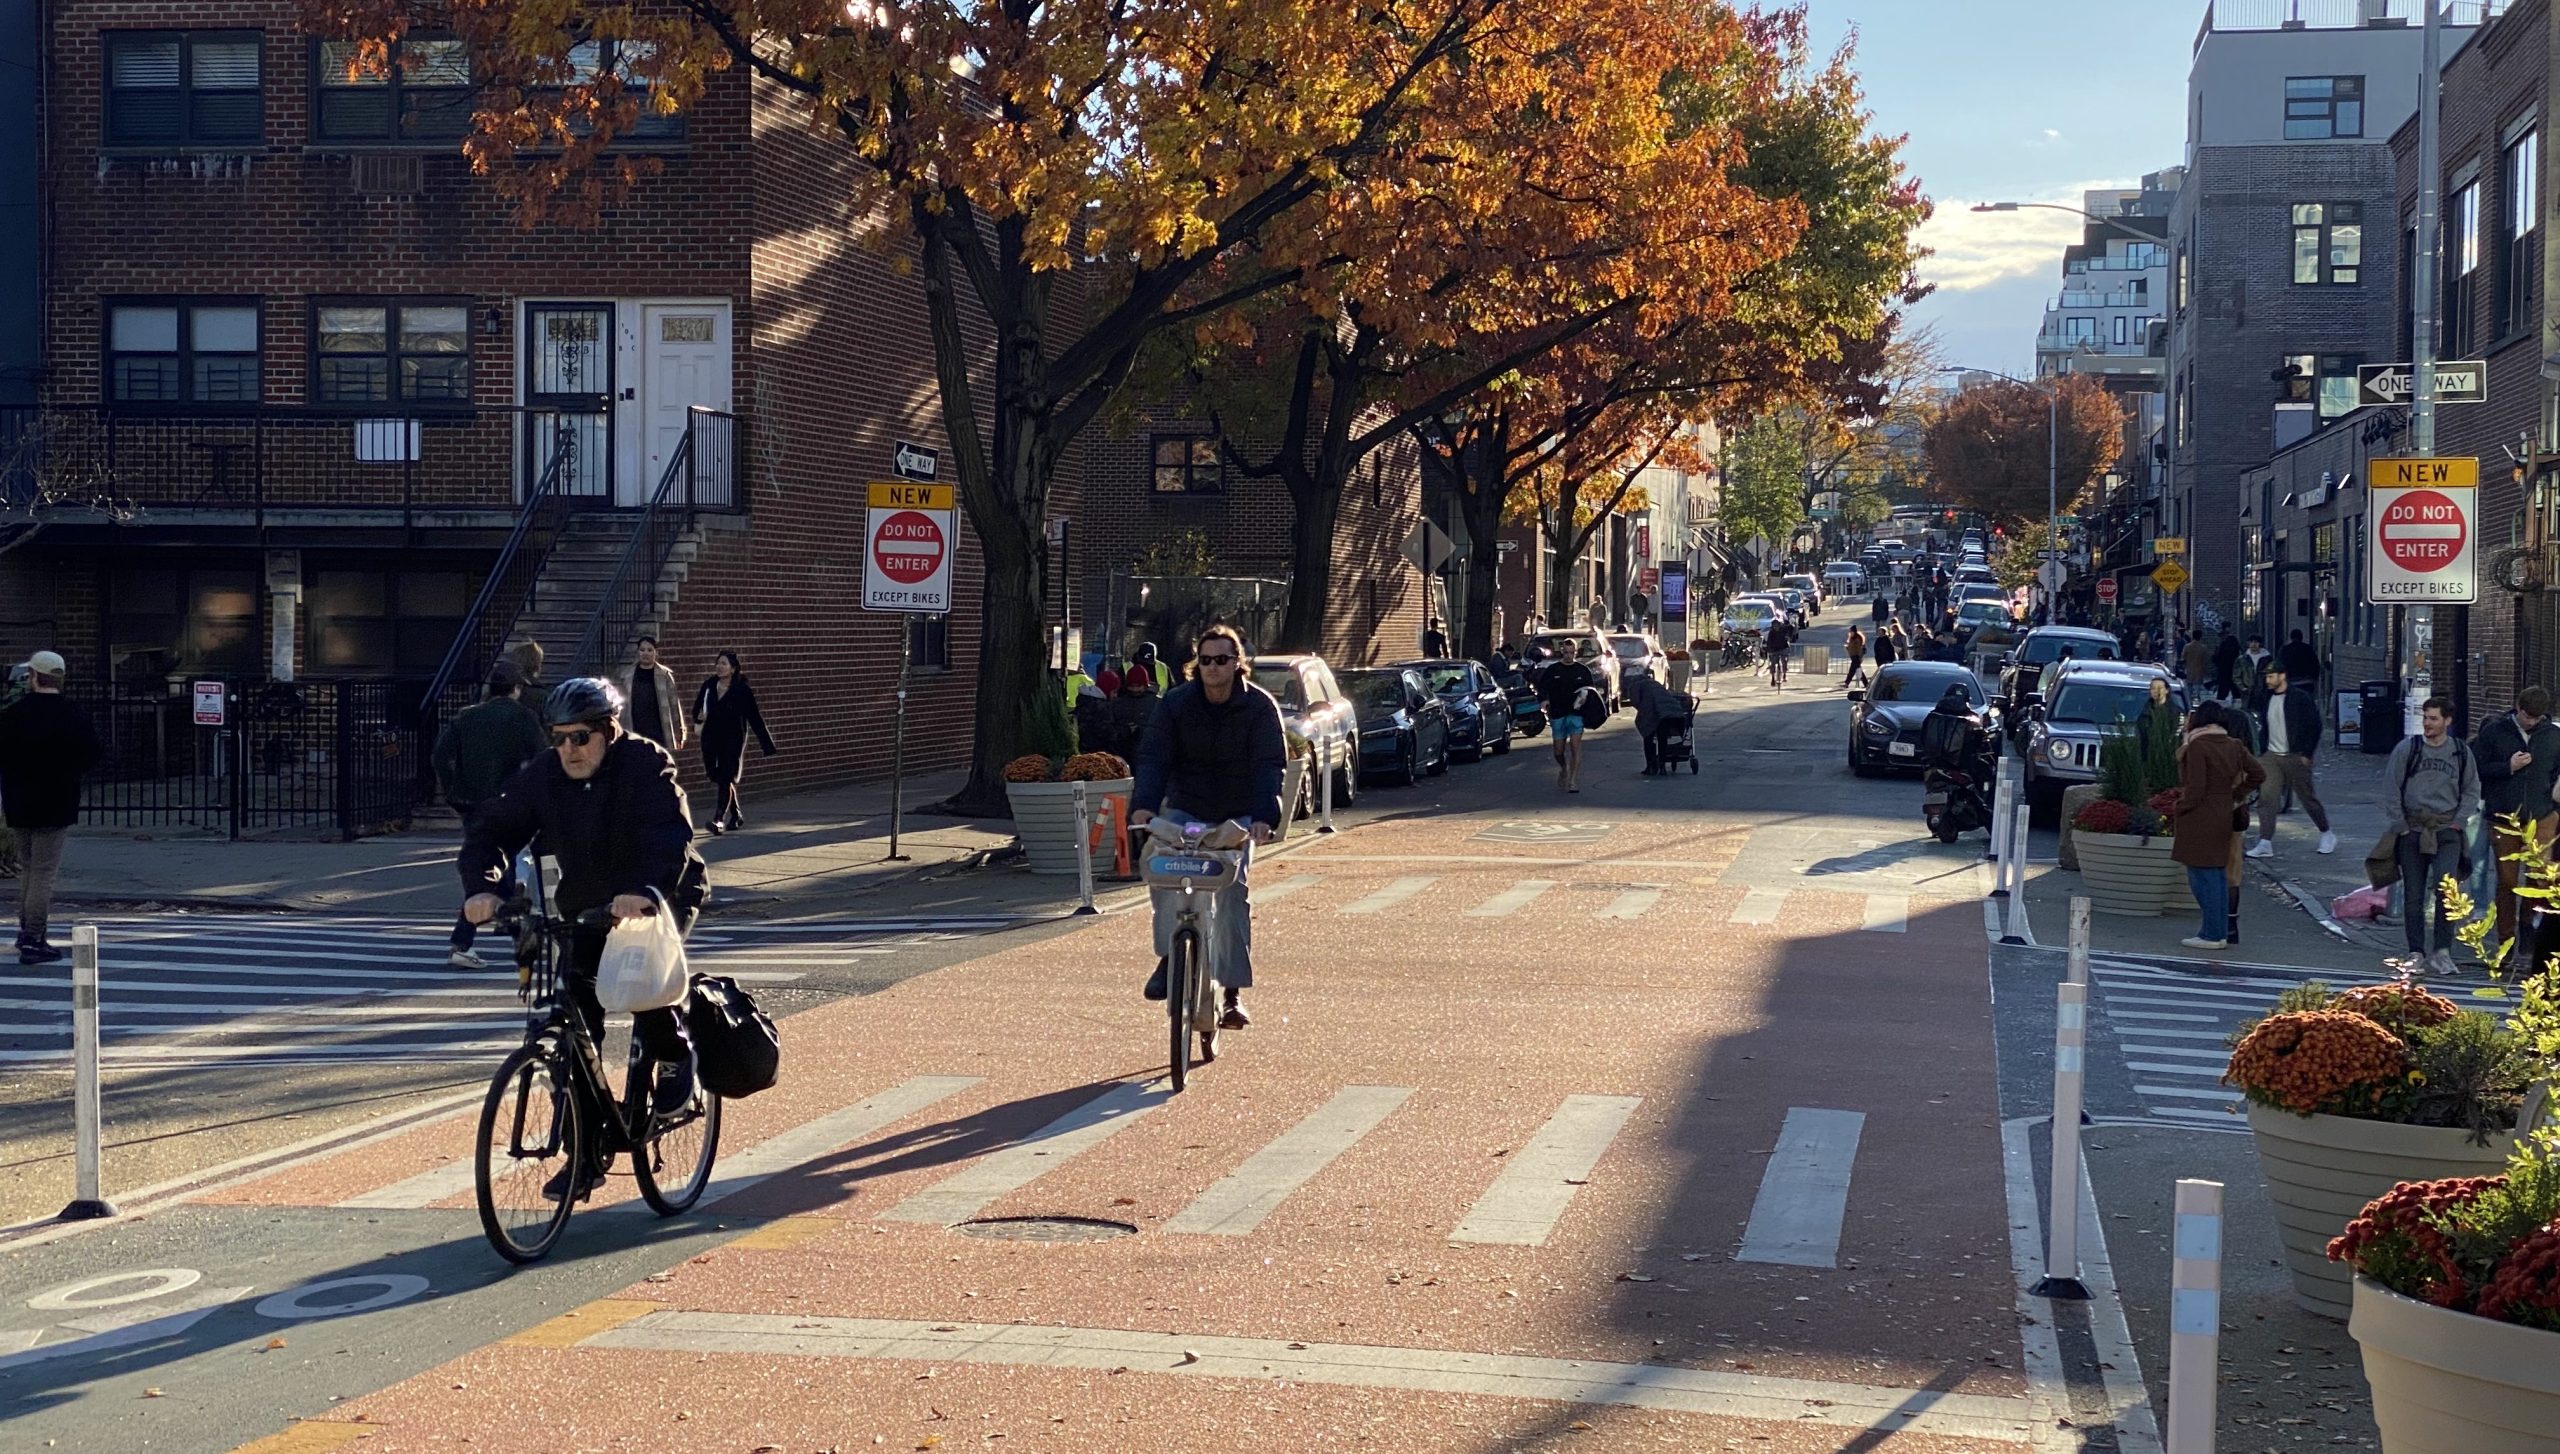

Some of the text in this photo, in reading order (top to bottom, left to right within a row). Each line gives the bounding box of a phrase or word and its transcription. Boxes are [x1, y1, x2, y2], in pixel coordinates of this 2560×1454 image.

[2378, 374, 2468, 392] ONE WAY
[900, 452, 932, 473] ONE WAY
[2398, 463, 2449, 483] NEW
[890, 487, 931, 504] NEW
[2392, 506, 2455, 520] DO NOT
[885, 524, 934, 538] DO NOT
[2158, 541, 2181, 550] NEW
[2395, 543, 2449, 558] ENTER
[886, 557, 930, 571] ENTER
[2098, 585, 2116, 593] STOP
[2381, 582, 2464, 594] EXCEPT BIKES
[872, 591, 940, 604] EXCEPT BIKES
[1164, 861, 1201, 871] citi bike
